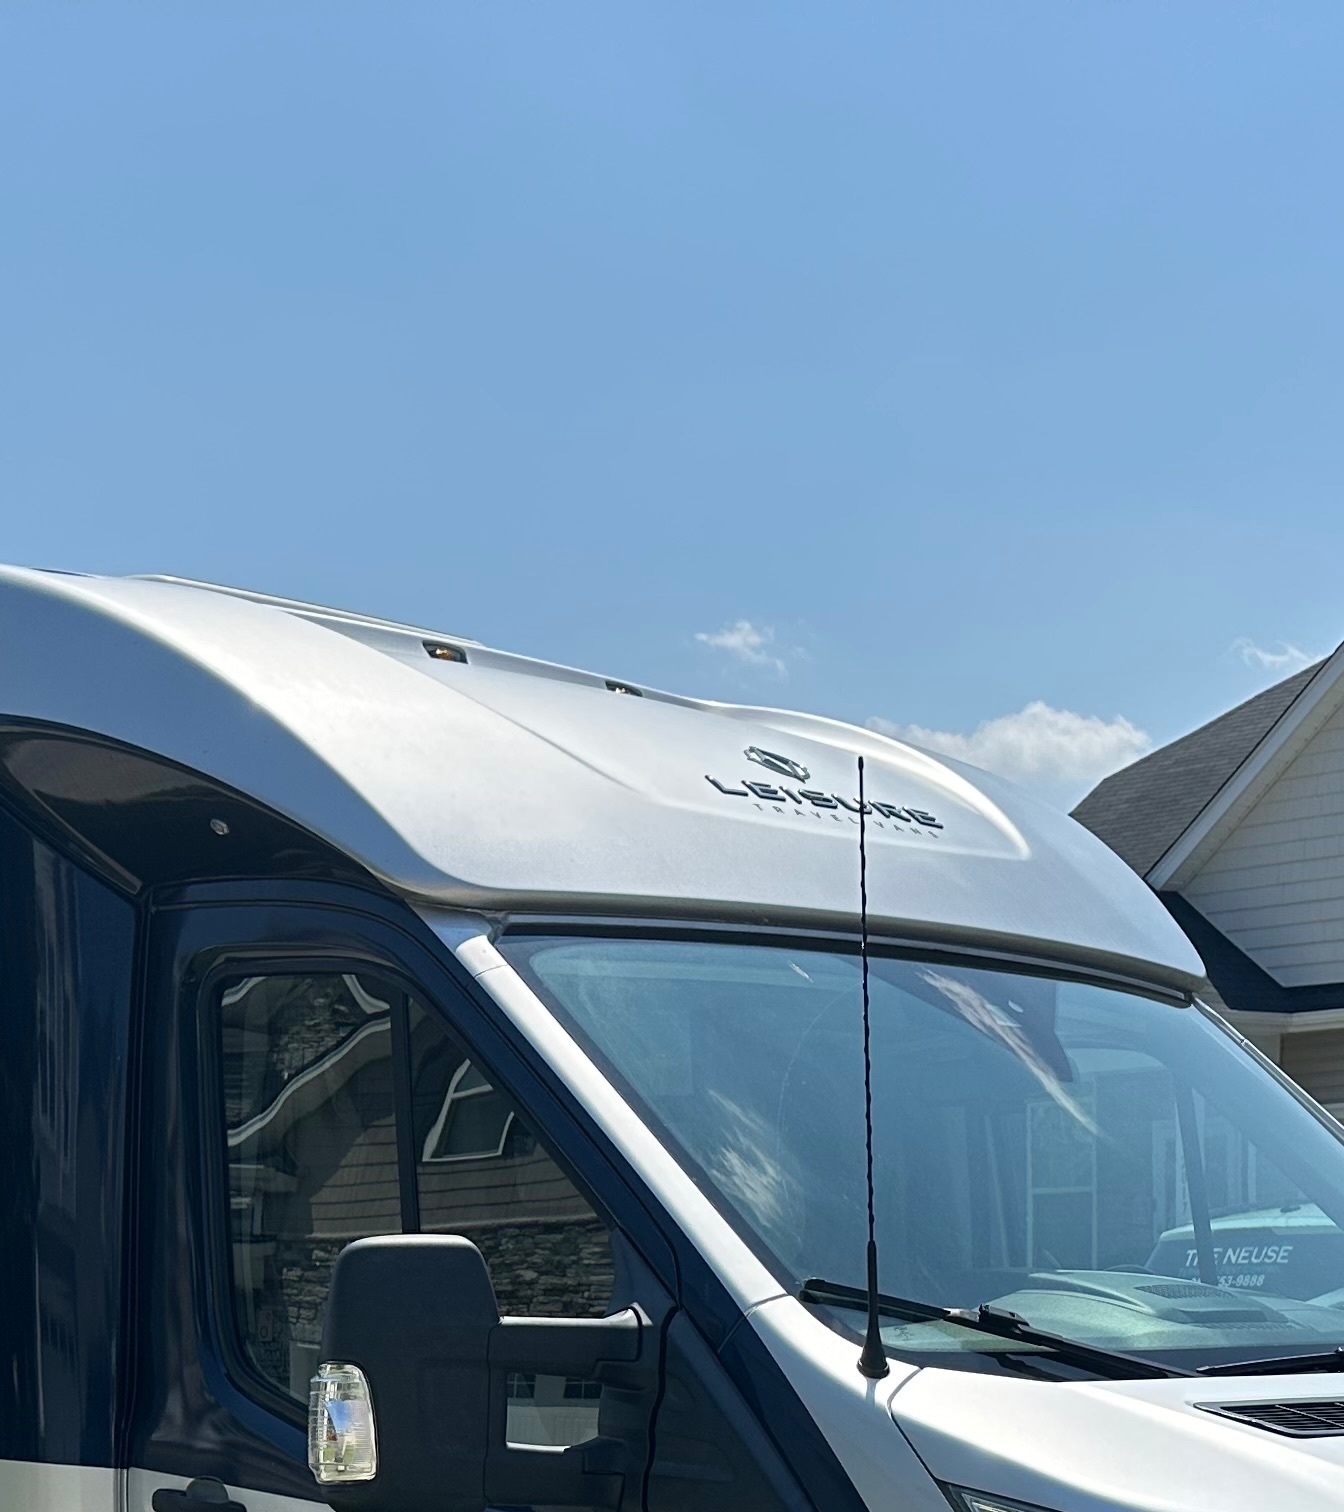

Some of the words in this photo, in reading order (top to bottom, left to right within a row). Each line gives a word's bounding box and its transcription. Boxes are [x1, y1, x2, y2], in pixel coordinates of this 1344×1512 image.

[705, 774, 944, 829] LEISURE
[753, 803, 860, 825] TRAVEL
[873, 820, 939, 839] VANS
[1223, 1246, 1294, 1265] NEUSE
